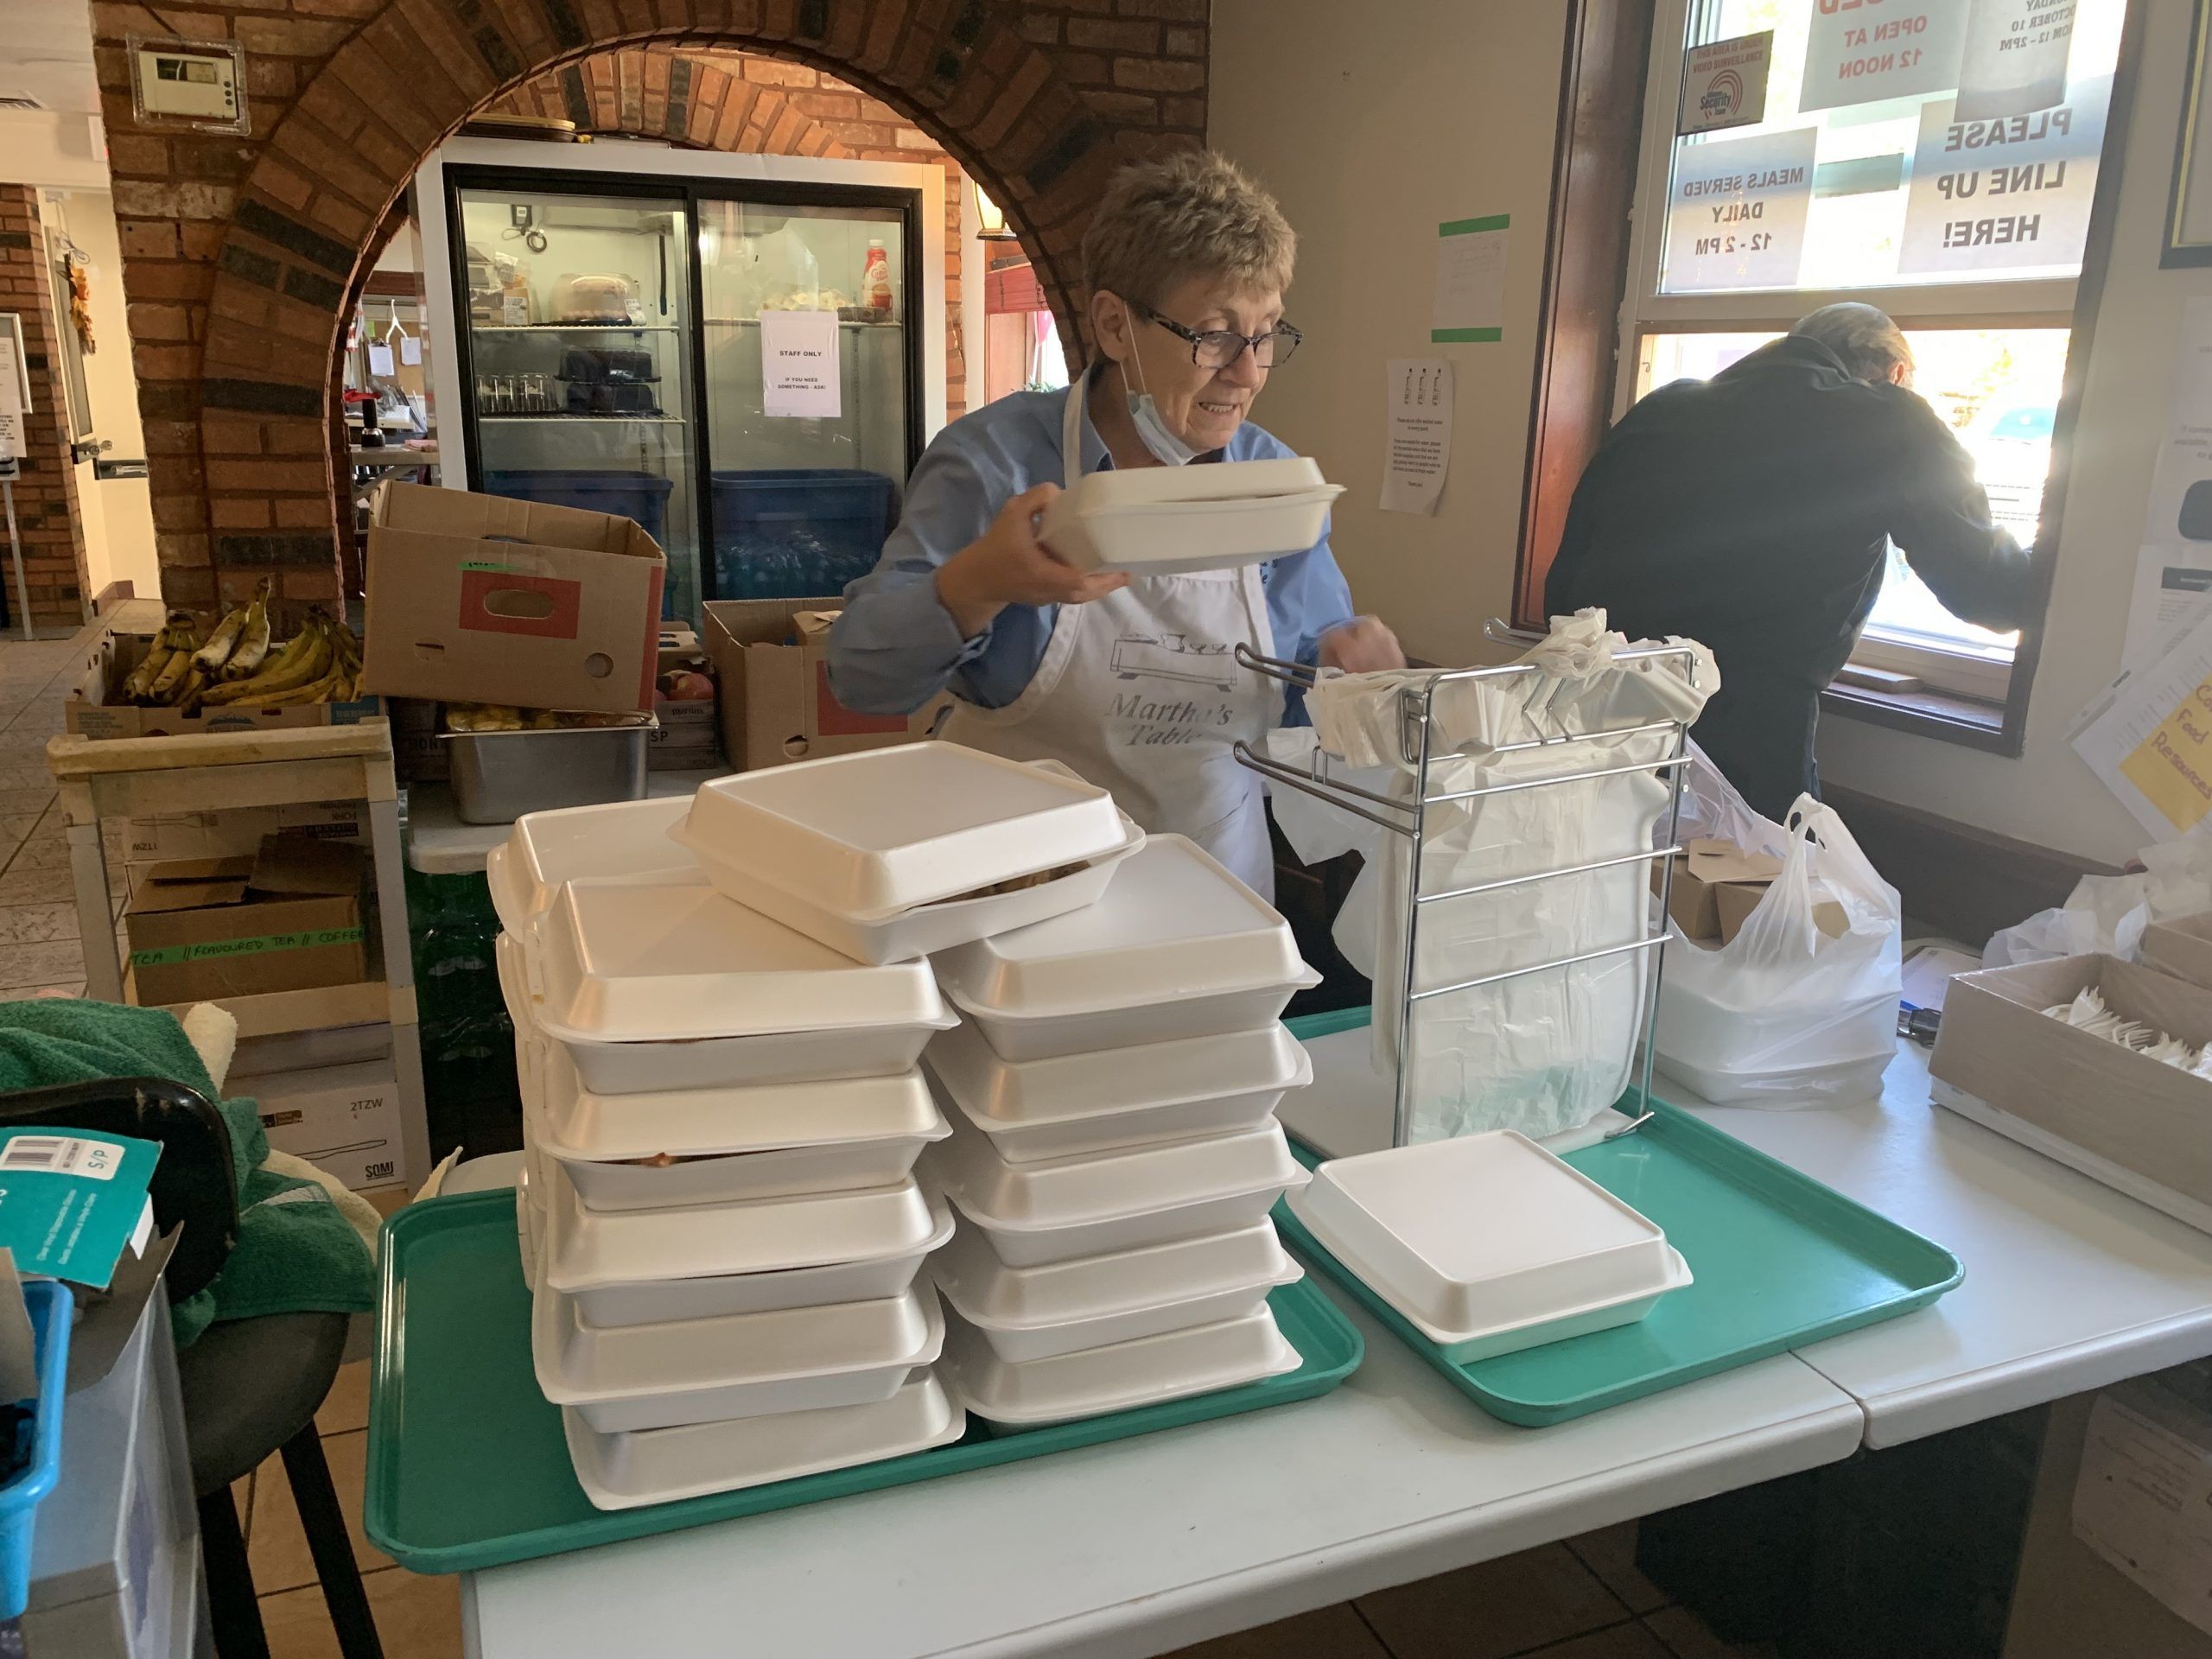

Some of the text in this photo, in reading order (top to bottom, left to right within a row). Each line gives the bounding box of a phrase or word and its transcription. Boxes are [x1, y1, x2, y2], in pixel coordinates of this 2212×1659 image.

[1694, 50, 1764, 73] VIDEO SURVEILLANCE
[1700, 92, 1732, 111] Security
[2177, 708, 2209, 745] Food
[132, 952, 163, 965] TEA
[272, 937, 296, 947] TEA
[319, 929, 364, 943] COFFEE
[350, 1098, 383, 1112] 2TZW
[87, 1149, 109, 1169] S/P
